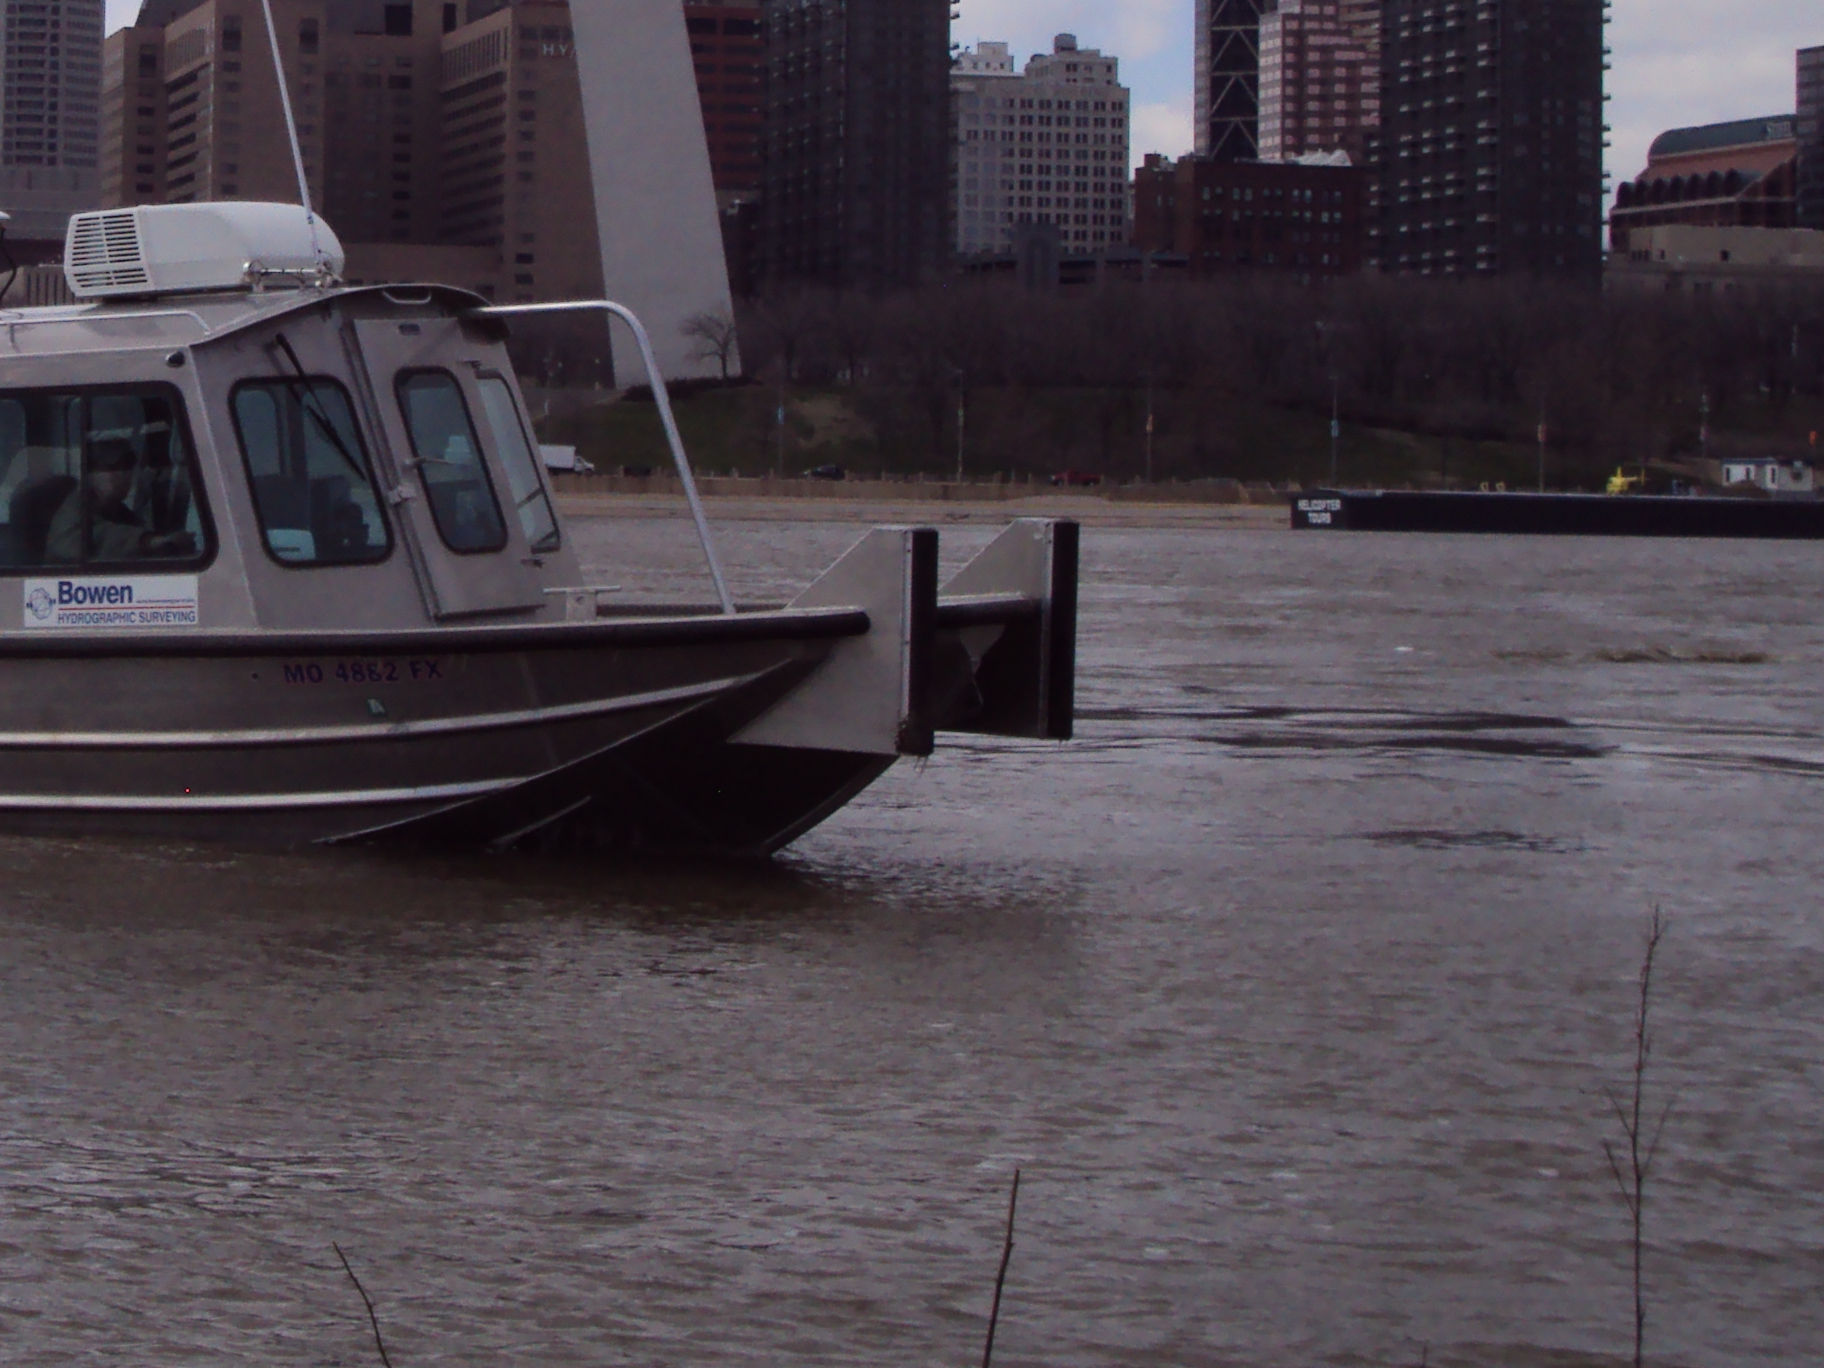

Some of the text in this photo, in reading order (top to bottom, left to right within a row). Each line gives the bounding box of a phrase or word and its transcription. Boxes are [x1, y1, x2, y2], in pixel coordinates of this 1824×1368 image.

[57, 581, 133, 605] Bowen
[57, 610, 196, 625] HYDROGRAPHIC SURVEYING
[283, 663, 324, 684] MO
[408, 659, 444, 680] FX
